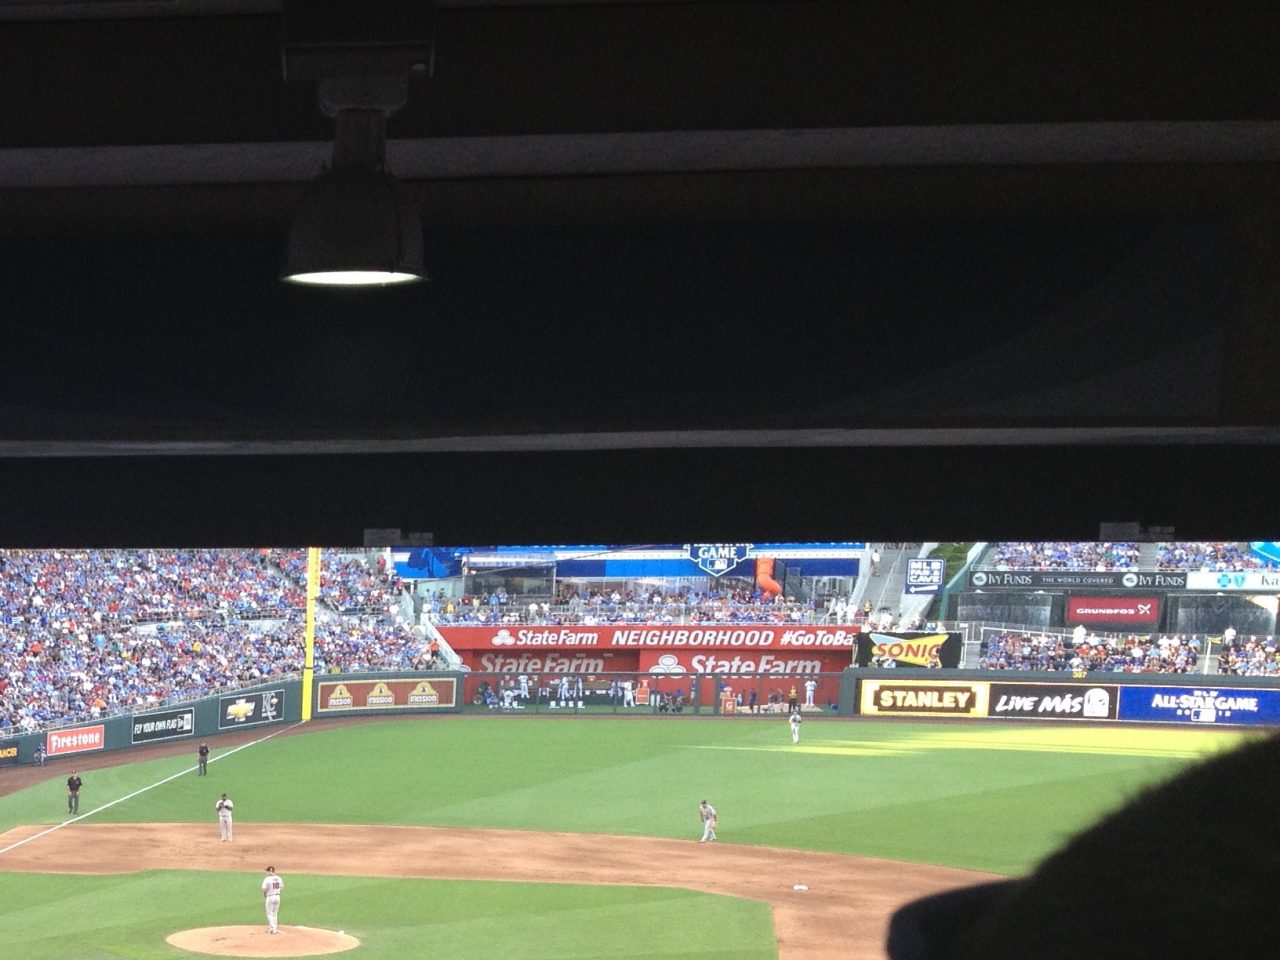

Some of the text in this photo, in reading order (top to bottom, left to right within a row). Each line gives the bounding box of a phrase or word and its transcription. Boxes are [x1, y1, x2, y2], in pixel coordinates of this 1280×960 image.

[698, 547, 738, 559] GAME
[911, 561, 941, 569] MLB
[1076, 607, 1135, 615] GRUNDFOS
[611, 629, 774, 646] NEIGHBORHOOD
[780, 629, 854, 646] #GoToBa
[880, 690, 971, 708] STANLEY
[51, 731, 100, 752] Firestone
